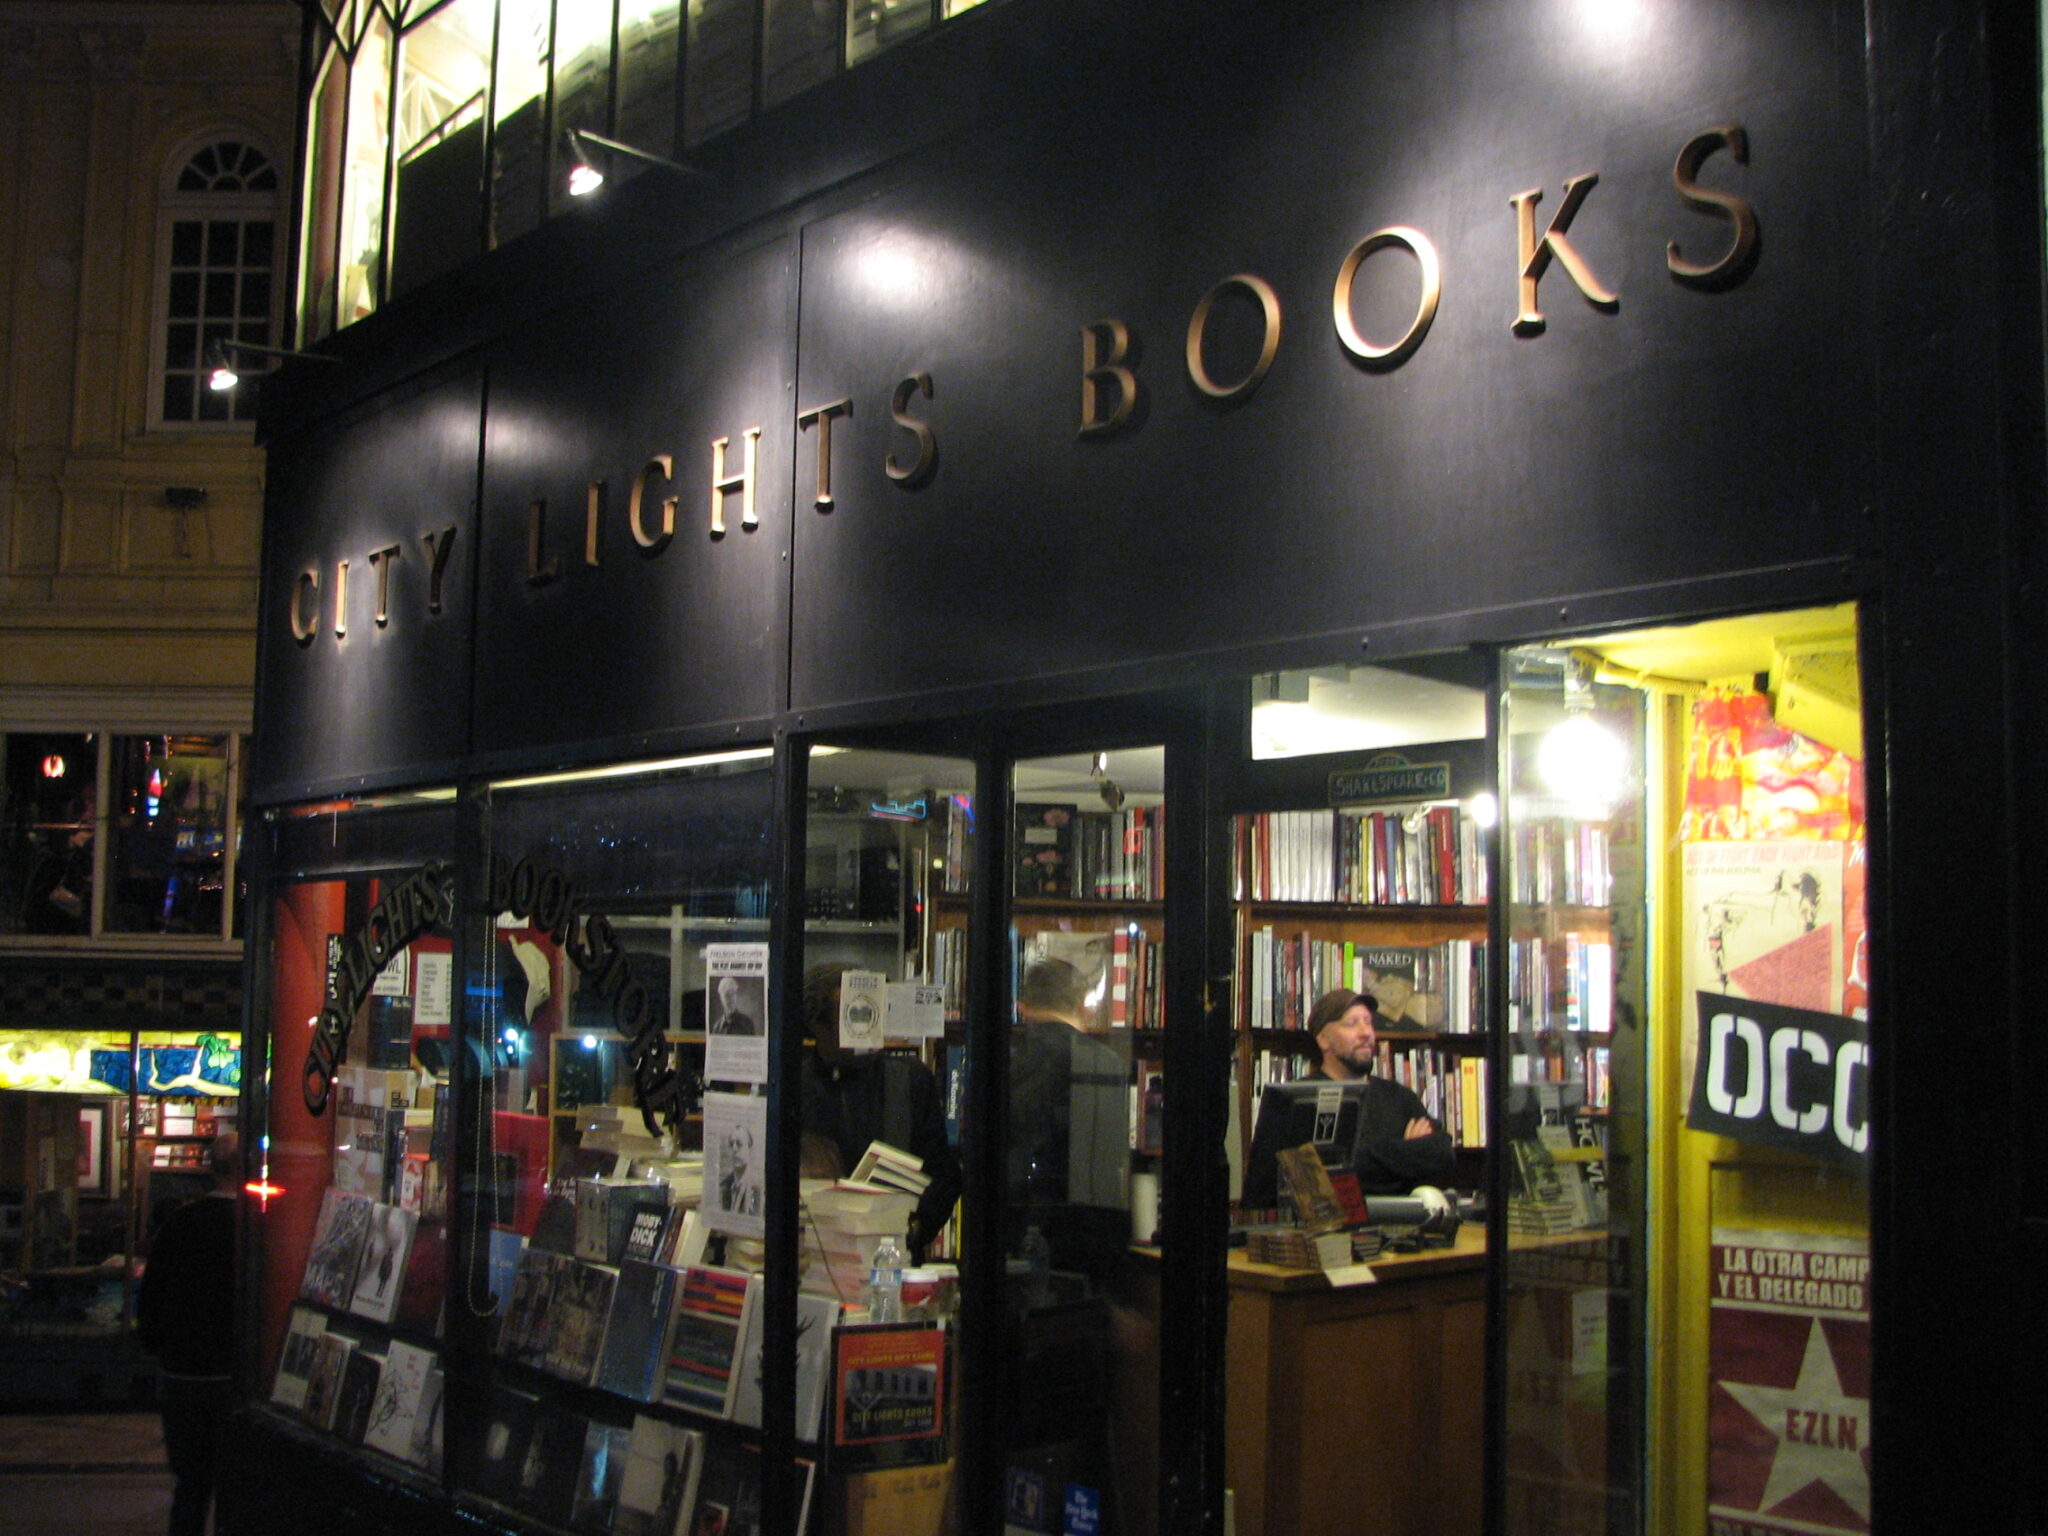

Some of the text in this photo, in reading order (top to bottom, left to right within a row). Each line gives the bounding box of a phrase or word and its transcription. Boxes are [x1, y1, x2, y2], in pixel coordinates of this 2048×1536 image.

[290, 124, 1760, 642] CITY LIGHTS BOOKS
[345, 860, 441, 1003] LIGHTS
[1369, 952, 1411, 966] NAKED
[629, 1227, 657, 1246] DICK
[1723, 1247, 1748, 1273] LA
[1751, 1249, 1805, 1277] OTRA
[1718, 1273, 1863, 1310] Y EL DELEGADO
[1786, 1408, 1858, 1451] EZLN
